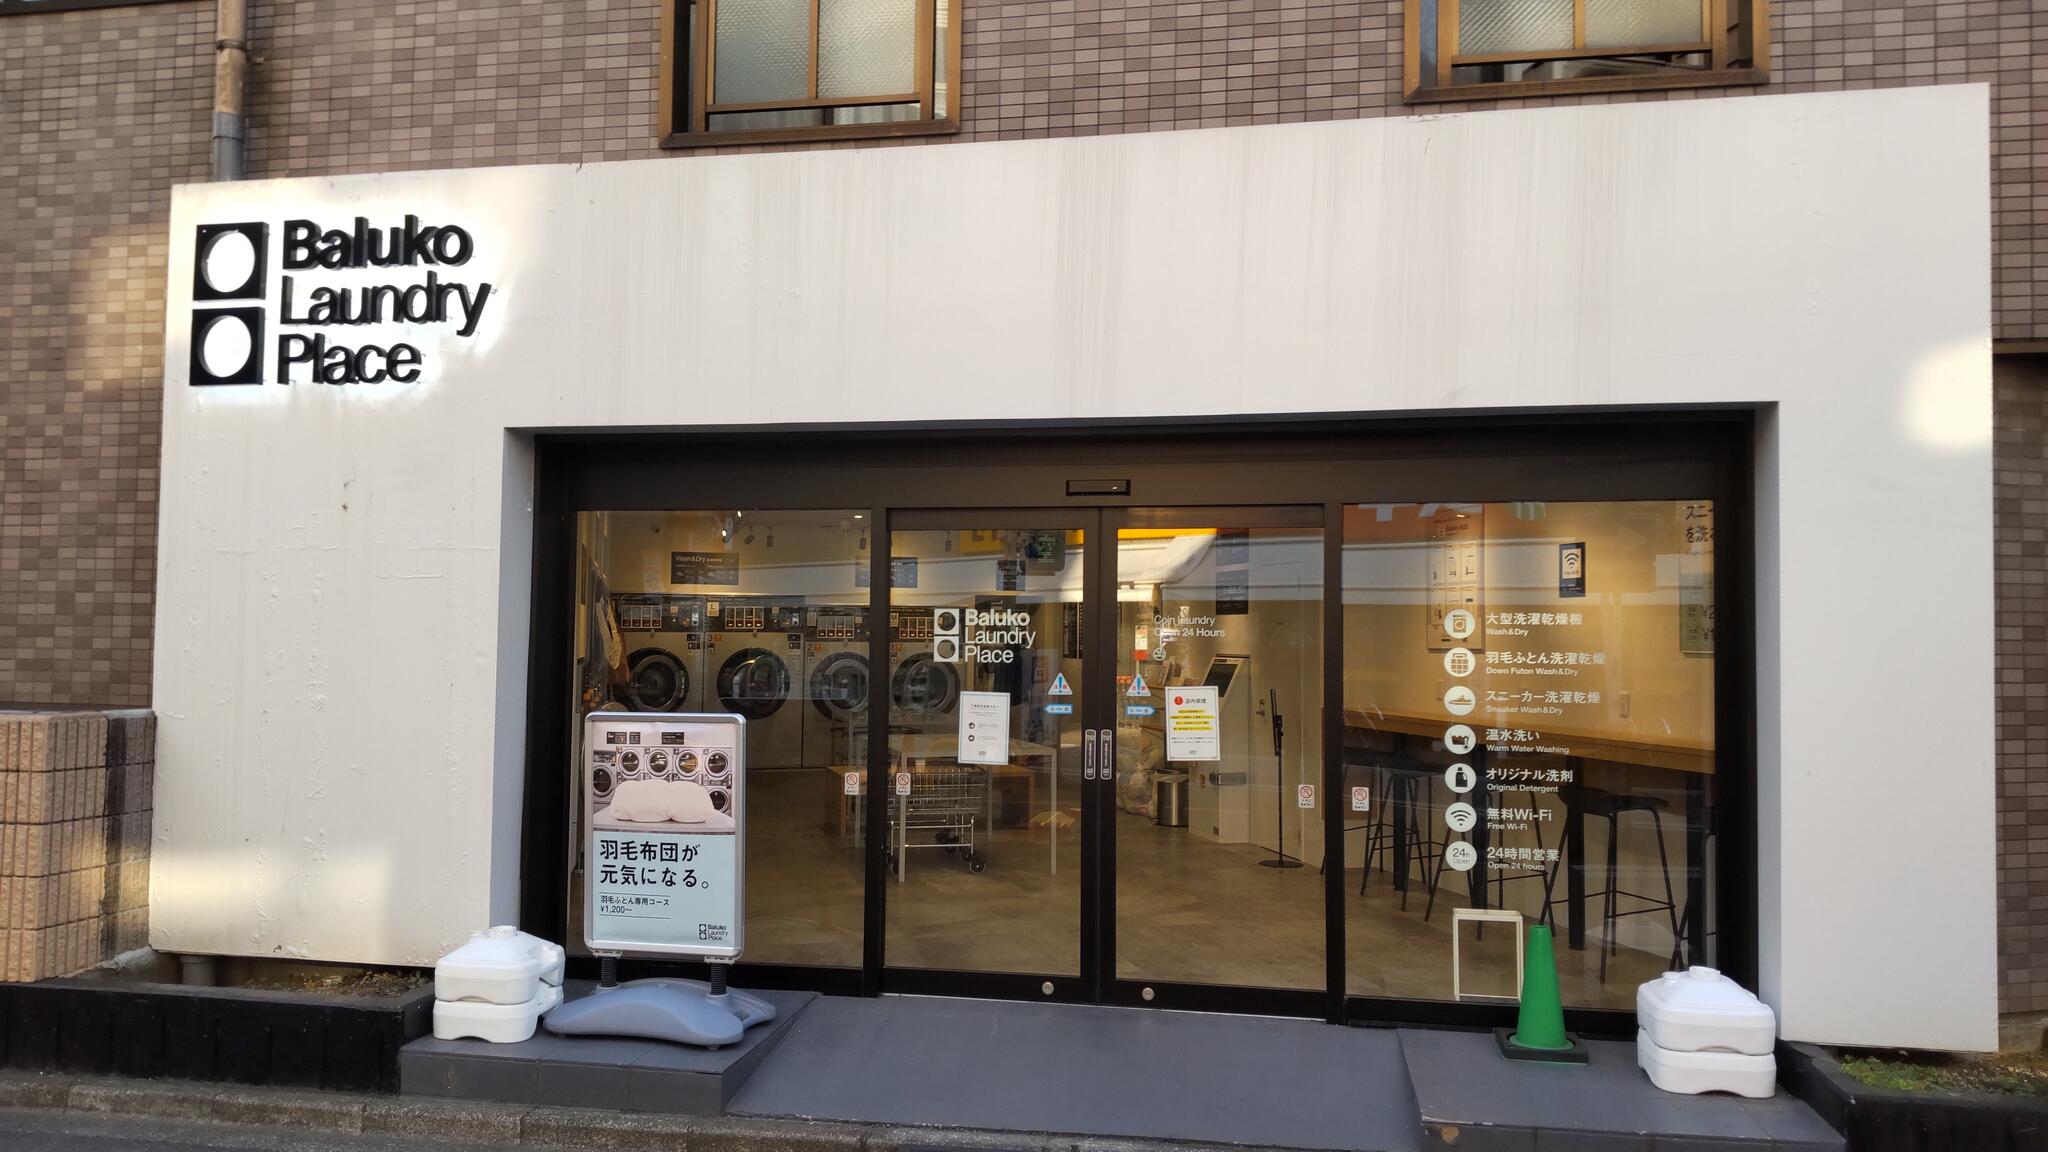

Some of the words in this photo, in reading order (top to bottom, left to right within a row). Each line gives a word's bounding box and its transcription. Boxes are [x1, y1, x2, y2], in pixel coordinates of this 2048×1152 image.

[282, 214, 473, 270] Baluko
[280, 270, 492, 337] Laundry
[277, 332, 422, 385] Place
[965, 608, 1031, 626] Baluko
[1154, 615, 1176, 625] Coin
[1177, 615, 1216, 627] Laundry
[1486, 612, 1583, 626] 大型洗濯乾燥機
[965, 626, 1036, 649] Laundry
[1154, 627, 1180, 638] On
[1182, 628, 1194, 637] 24
[1196, 628, 1226, 637] Hours
[1486, 628, 1529, 637] Wash&Dry
[965, 645, 1014, 663] Place
[1486, 651, 1606, 665] 羽毛ふとん洗濯乾燥
[1486, 667, 1509, 675] Down
[1510, 667, 1534, 675] Futon
[1536, 668, 1579, 677] Wash&Dry
[1486, 690, 1601, 704] スニーカー洗濯乾燥
[1486, 706, 1519, 714] Sneaker
[1520, 706, 1563, 716] Wash&Dry
[1486, 728, 1540, 742] 温水洗い
[1486, 744, 1510, 752] Warm
[1511, 745, 1535, 753] Water
[1535, 745, 1570, 755] Washing
[1486, 767, 1574, 783] オリジナル洗剤
[1486, 783, 1518, 793] Original
[1519, 783, 1559, 793] Detergent
[1487, 807, 1552, 821] 無料Wi-Fi
[1487, 822, 1506, 830] Free
[600, 839, 701, 863] 羽毛布団が
[1452, 847, 1471, 857] 24h
[1486, 846, 1560, 862] 24時間営業
[1487, 861, 1510, 870] Open
[1511, 862, 1521, 870] 24
[1522, 862, 1546, 871] hours
[600, 864, 709, 890] 元気になる。
[600, 895, 670, 907] 羽毛ふとん専用コース
